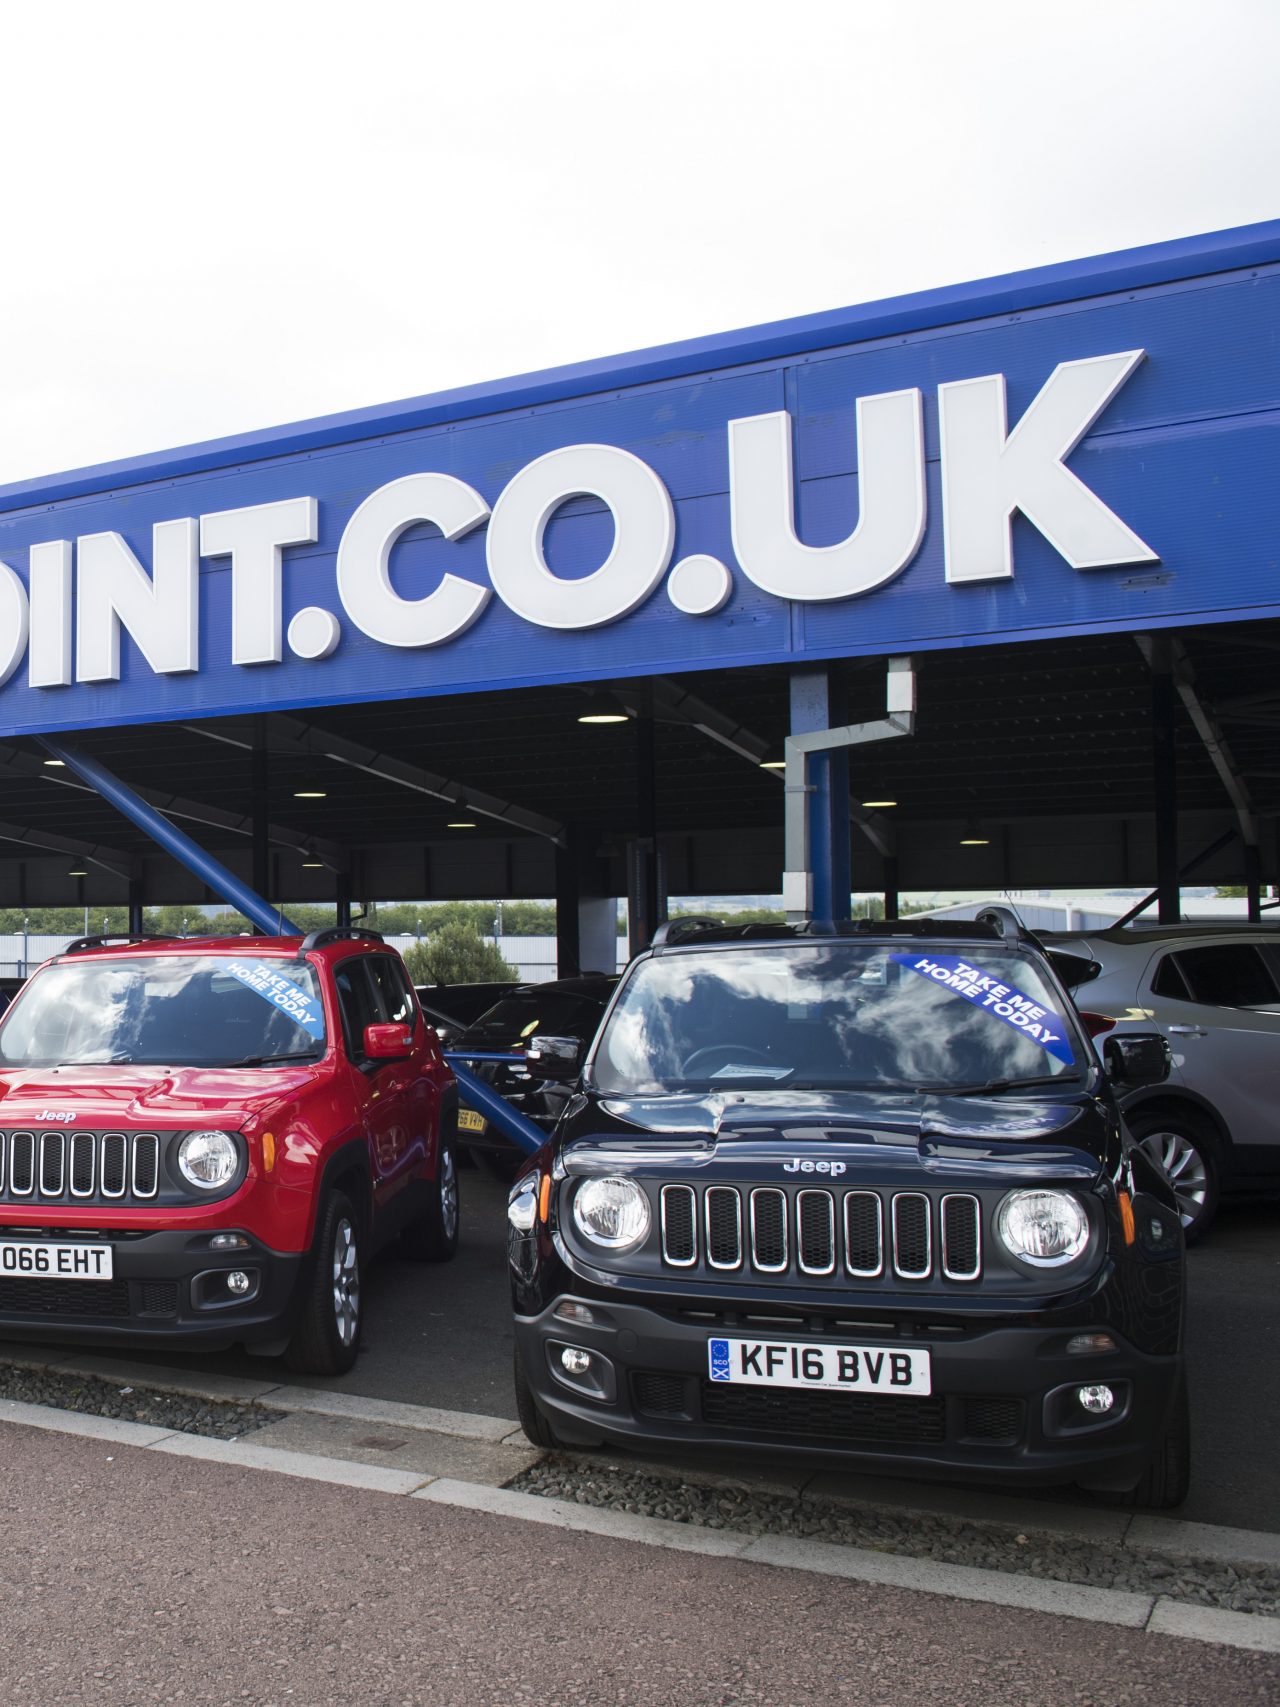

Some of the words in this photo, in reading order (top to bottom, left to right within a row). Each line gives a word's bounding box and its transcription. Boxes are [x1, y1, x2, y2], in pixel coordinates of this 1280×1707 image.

[226, 962, 270, 991] HOME
[266, 987, 317, 1024] TODAY
[253, 964, 290, 990] TAKE
[285, 987, 312, 1007] ME
[913, 958, 983, 998] HOME
[981, 993, 1061, 1043] TODAY
[951, 962, 1011, 998] TAKE
[1006, 994, 1048, 1021] ME
[35, 1110, 76, 1124] Jeep
[783, 1158, 847, 1176] Jeep
[57, 1248, 105, 1274] EHT
[740, 1343, 824, 1380] KF16
[837, 1350, 913, 1386] BVB
